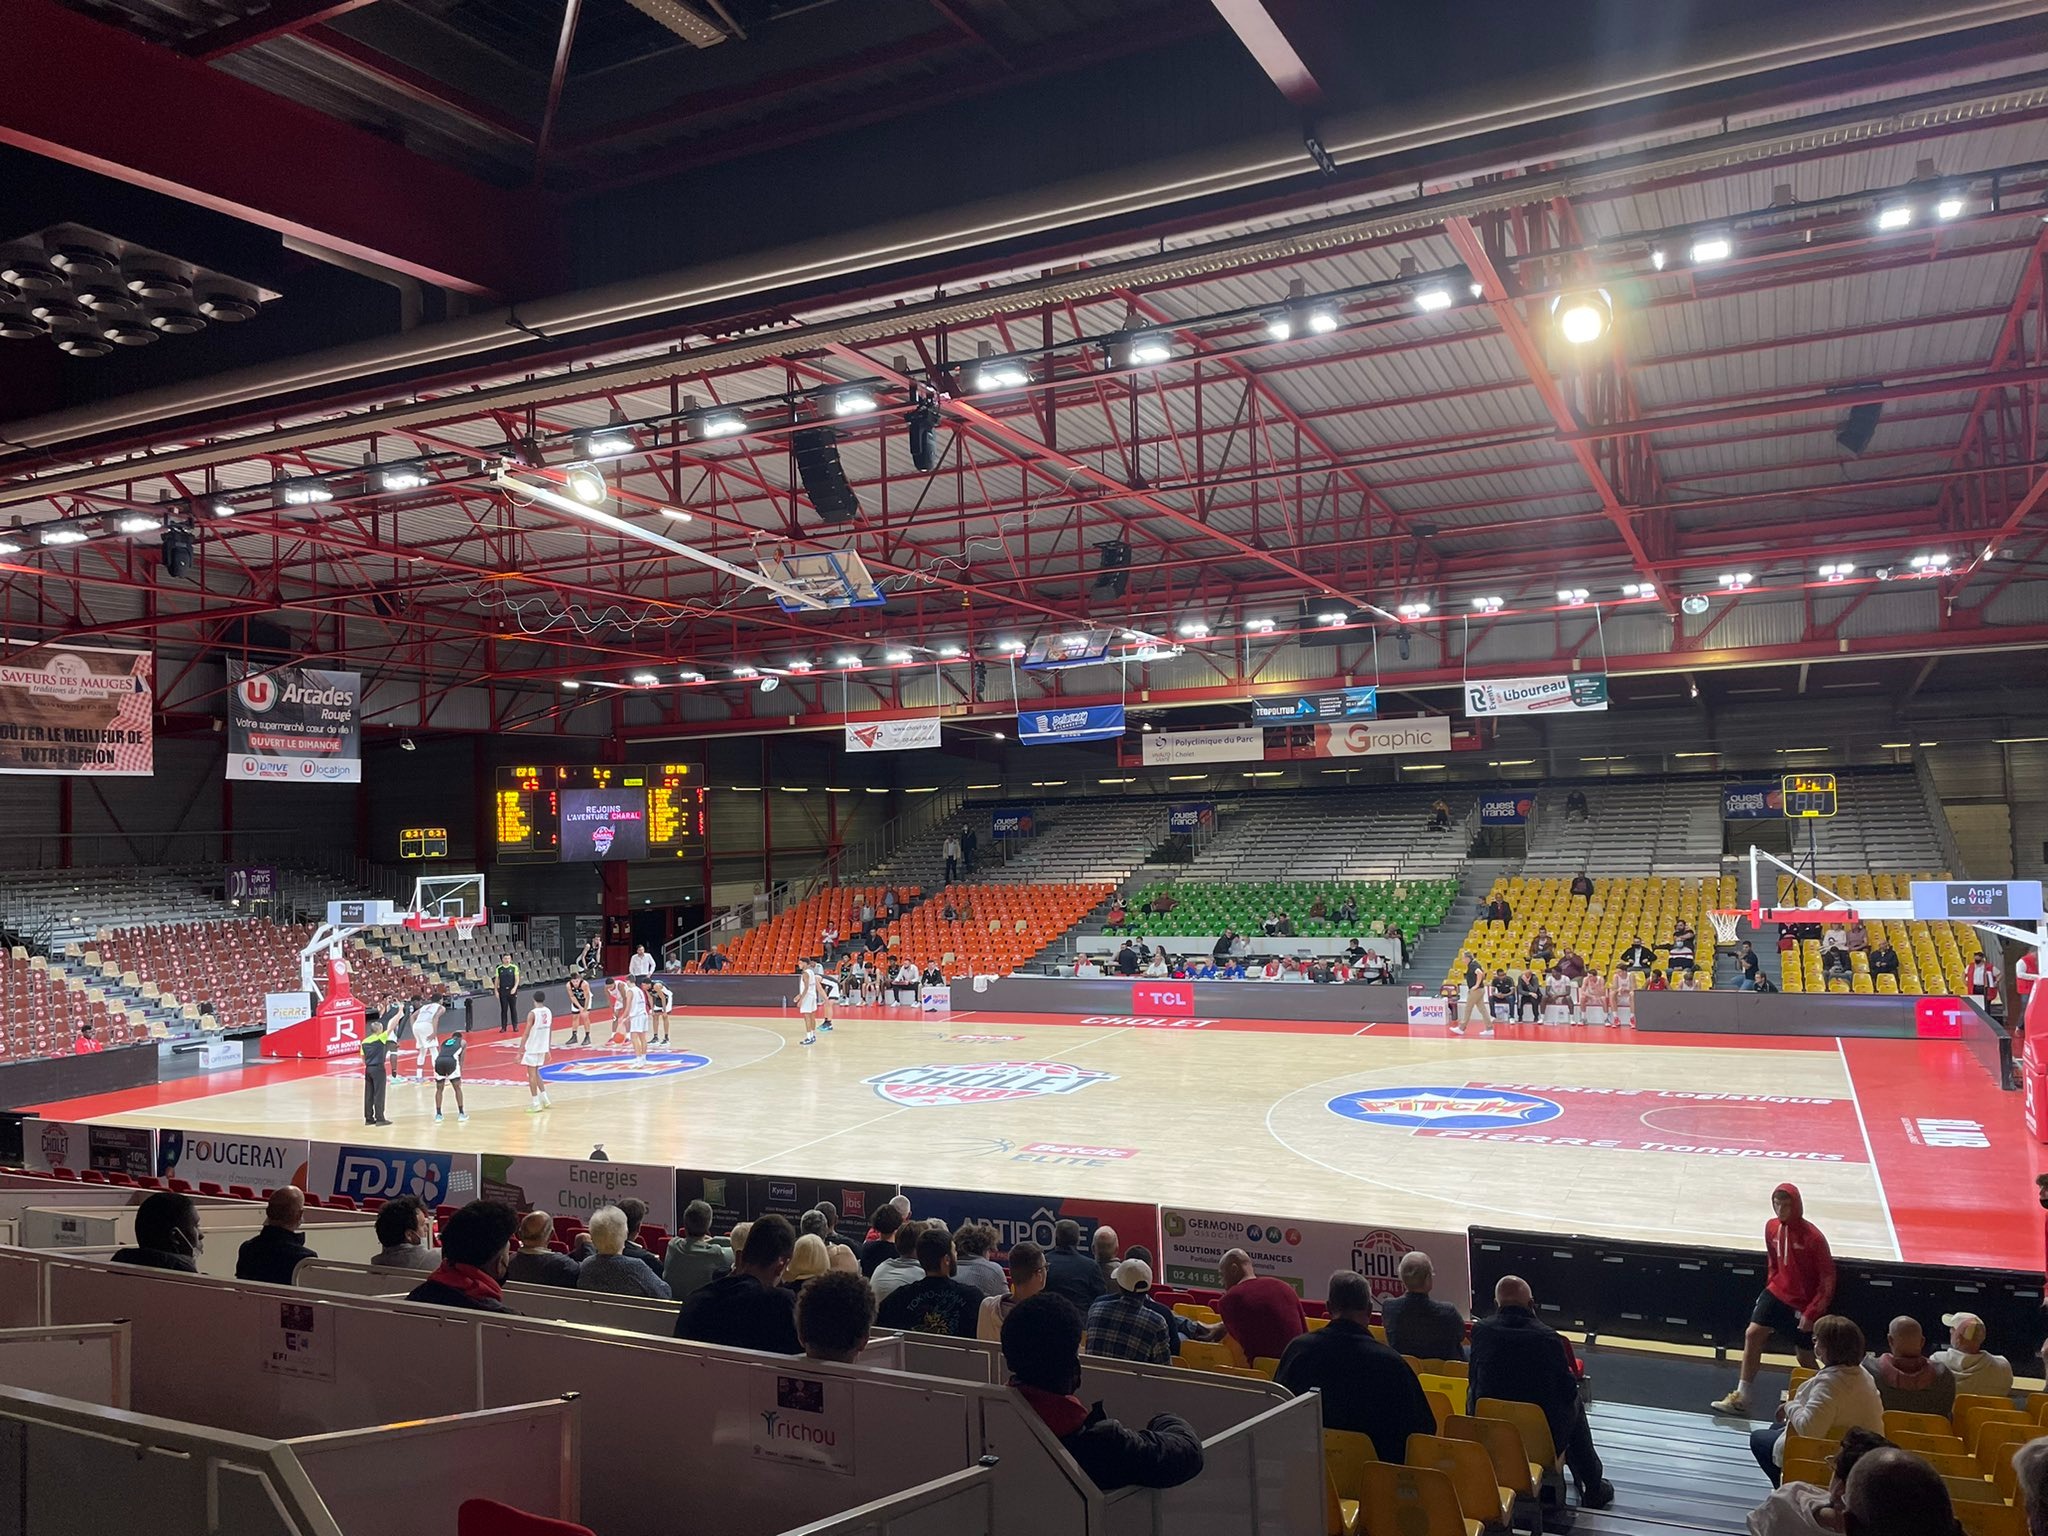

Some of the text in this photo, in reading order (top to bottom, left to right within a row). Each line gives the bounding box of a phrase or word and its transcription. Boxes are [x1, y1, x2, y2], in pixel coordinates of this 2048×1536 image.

[1, 669, 133, 690] SAVEURS DES MAUGES
[33, 685, 67, 695] traditions
[68, 687, 78, 695] de
[281, 683, 353, 706] Arcades
[1503, 680, 1567, 701] Liboureau
[320, 708, 352, 723] Rougé
[236, 718, 258, 729] Votre
[259, 721, 304, 733] supermarché
[327, 725, 337, 734] de
[48, 727, 61, 741] LE
[63, 728, 124, 743] MEILLEUR
[127, 730, 143, 744] DE
[1344, 723, 1433, 753] Graphic
[251, 737, 340, 750] OUVERT LE DIMANCHE
[1175, 738, 1223, 747] Polyclinique
[21, 747, 66, 763] VOTRE
[260, 763, 288, 772] DRIVE
[316, 762, 350, 775] location
[1729, 792, 1763, 803] ouest
[586, 805, 621, 814] REJOINS
[1485, 800, 1515, 810] ouest
[1726, 800, 1764, 812] france
[566, 811, 640, 822] L'AVENTURE CHARAL
[1174, 811, 1198, 820] ouest
[1482, 807, 1516, 817] france
[994, 823, 1019, 831] france
[1171, 818, 1198, 826] france
[251, 875, 271, 884] PAYS
[1968, 887, 2003, 899] Angle
[1951, 896, 1993, 905] de Vue
[1150, 992, 1187, 1006] TCL
[1080, 1016, 1221, 1028] CHOLET
[867, 1068, 1111, 1093] CHOLET
[41, 1135, 69, 1154] CHOLET
[1034, 1143, 1130, 1159] Betclic
[127, 1151, 147, 1162] -10%
[186, 1139, 287, 1169] FOUGERAY
[1640, 1141, 1846, 1162] Transports
[1009, 1153, 1112, 1168] ELITE
[340, 1155, 406, 1196] FDJ
[569, 1164, 638, 1190] Energies
[845, 1197, 861, 1208] ibis
[1188, 1218, 1245, 1232] GERMOND
[1193, 1229, 1240, 1241] associés
[1173, 1244, 1222, 1256] SOLUTIONS
[1351, 1249, 1402, 1279] CHOL
[1173, 1270, 1185, 1280] 02
[1187, 1272, 1200, 1282] 41
[1202, 1274, 1216, 1283] 65
